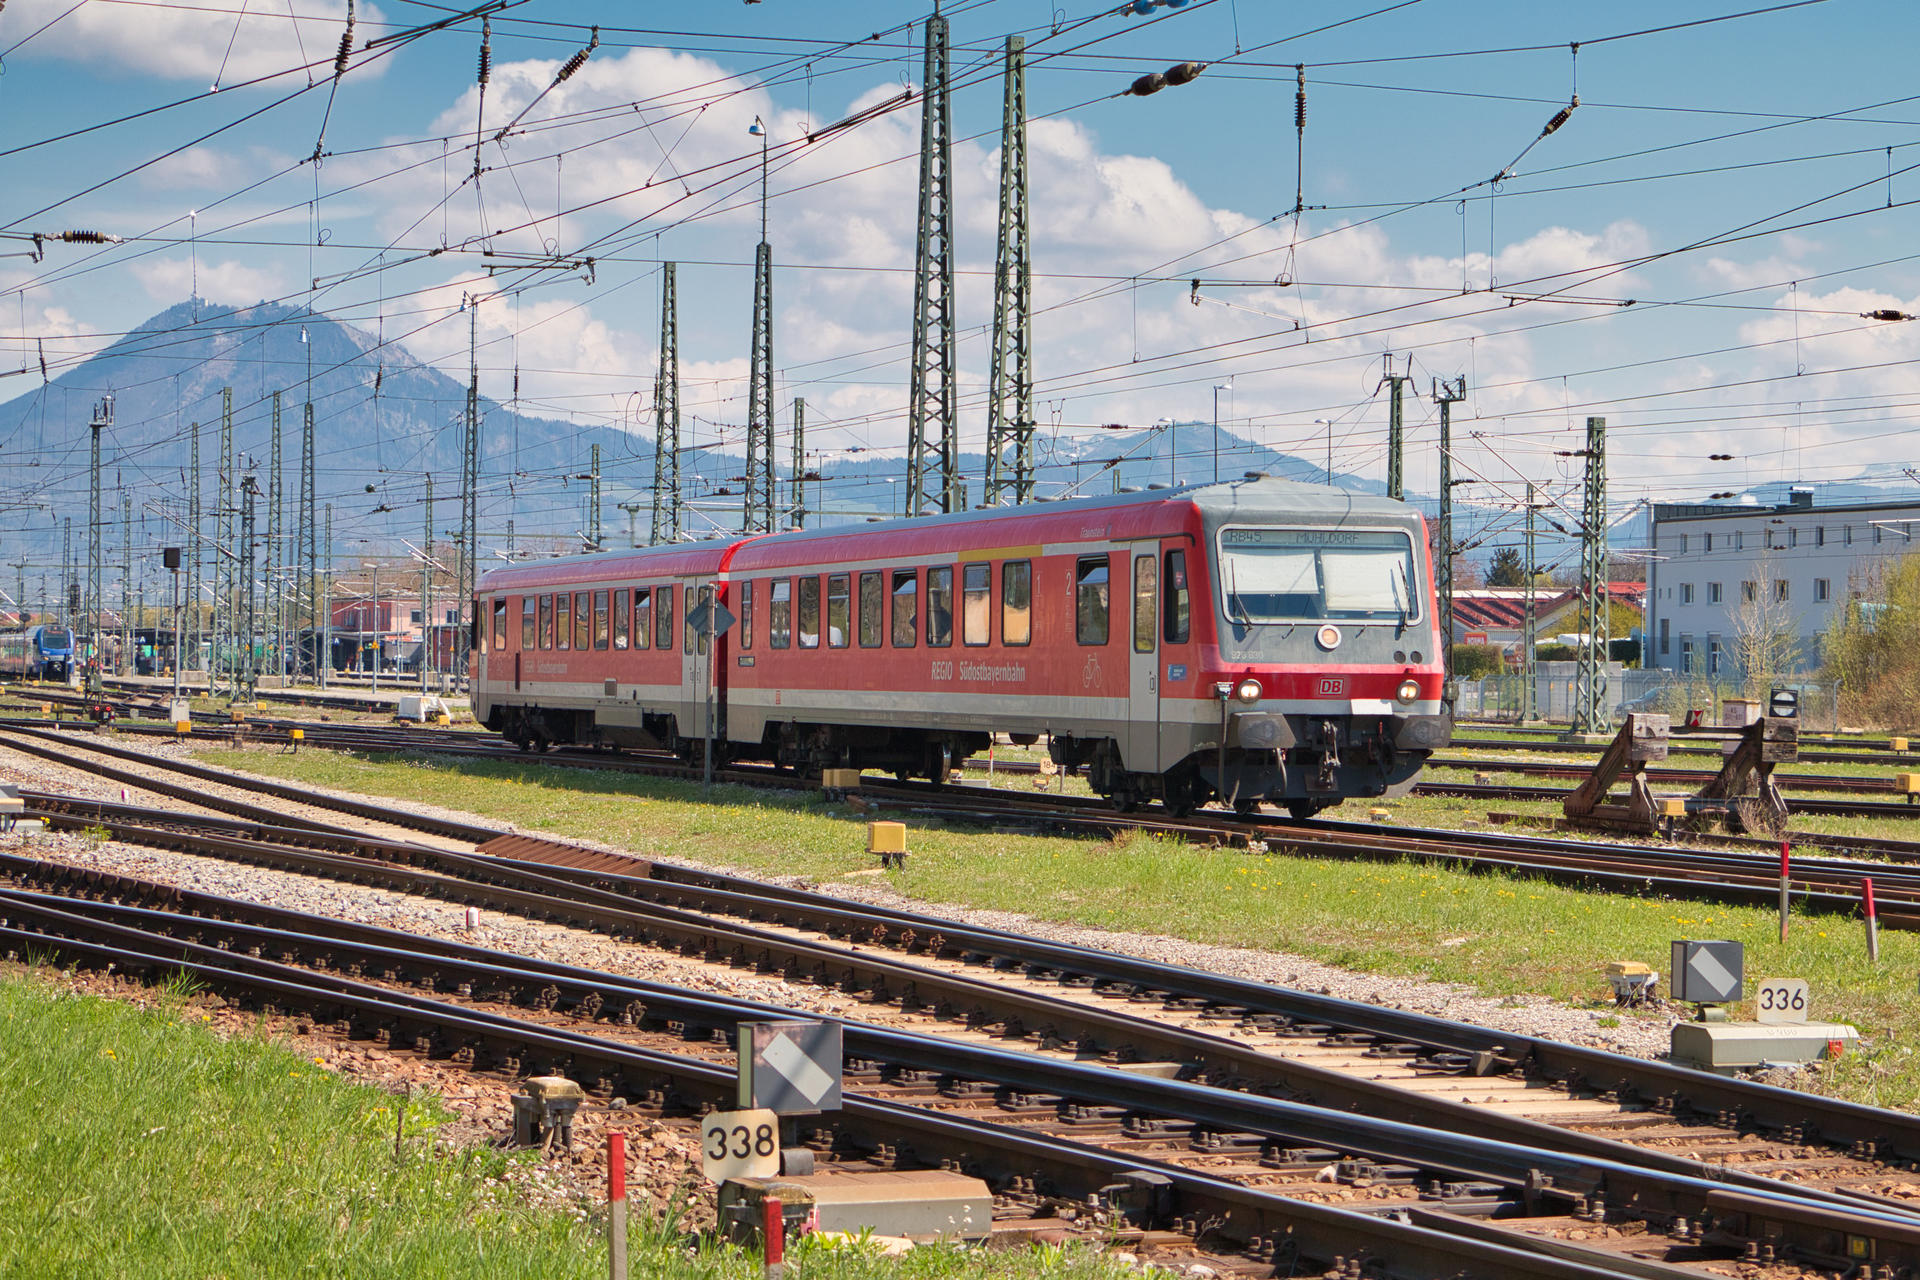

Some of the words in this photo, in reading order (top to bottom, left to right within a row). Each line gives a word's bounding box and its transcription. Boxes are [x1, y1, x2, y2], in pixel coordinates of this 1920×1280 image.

[1230, 531, 1262, 543] RB45
[1065, 571, 1072, 596] 2
[931, 661, 953, 681] REGIO
[959, 661, 1026, 686] Südostbayernbahn
[1321, 680, 1341, 693] DB
[1760, 988, 1805, 1011] 336
[707, 1123, 775, 1161] 338
